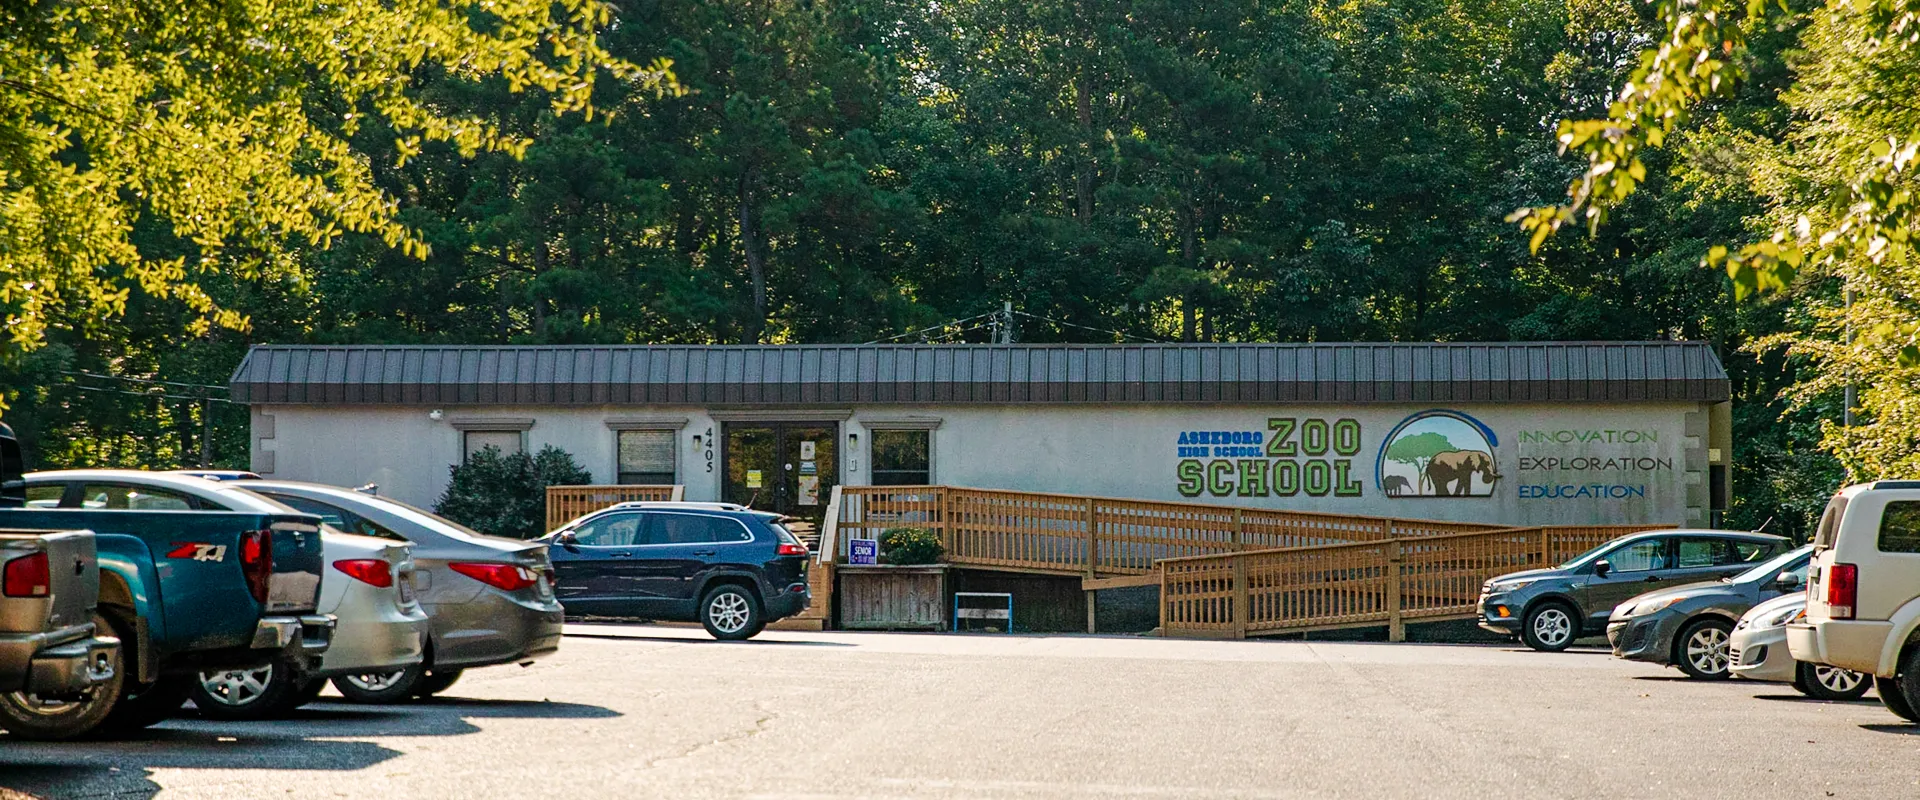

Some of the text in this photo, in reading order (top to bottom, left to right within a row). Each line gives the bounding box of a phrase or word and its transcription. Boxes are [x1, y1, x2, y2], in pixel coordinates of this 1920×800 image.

[1177, 431, 1263, 445] ASHEBORO
[1266, 418, 1361, 457] ZOO
[1518, 430, 1658, 443] INNOVATION
[705, 427, 713, 473] 4405
[1178, 446, 1263, 457] HIGH SCHOOL
[1519, 457, 1672, 471] EXPLORATION
[1177, 459, 1362, 497] SCHOOL
[1518, 485, 1645, 499] EDUCATION
[854, 546, 872, 555] SENIOR
